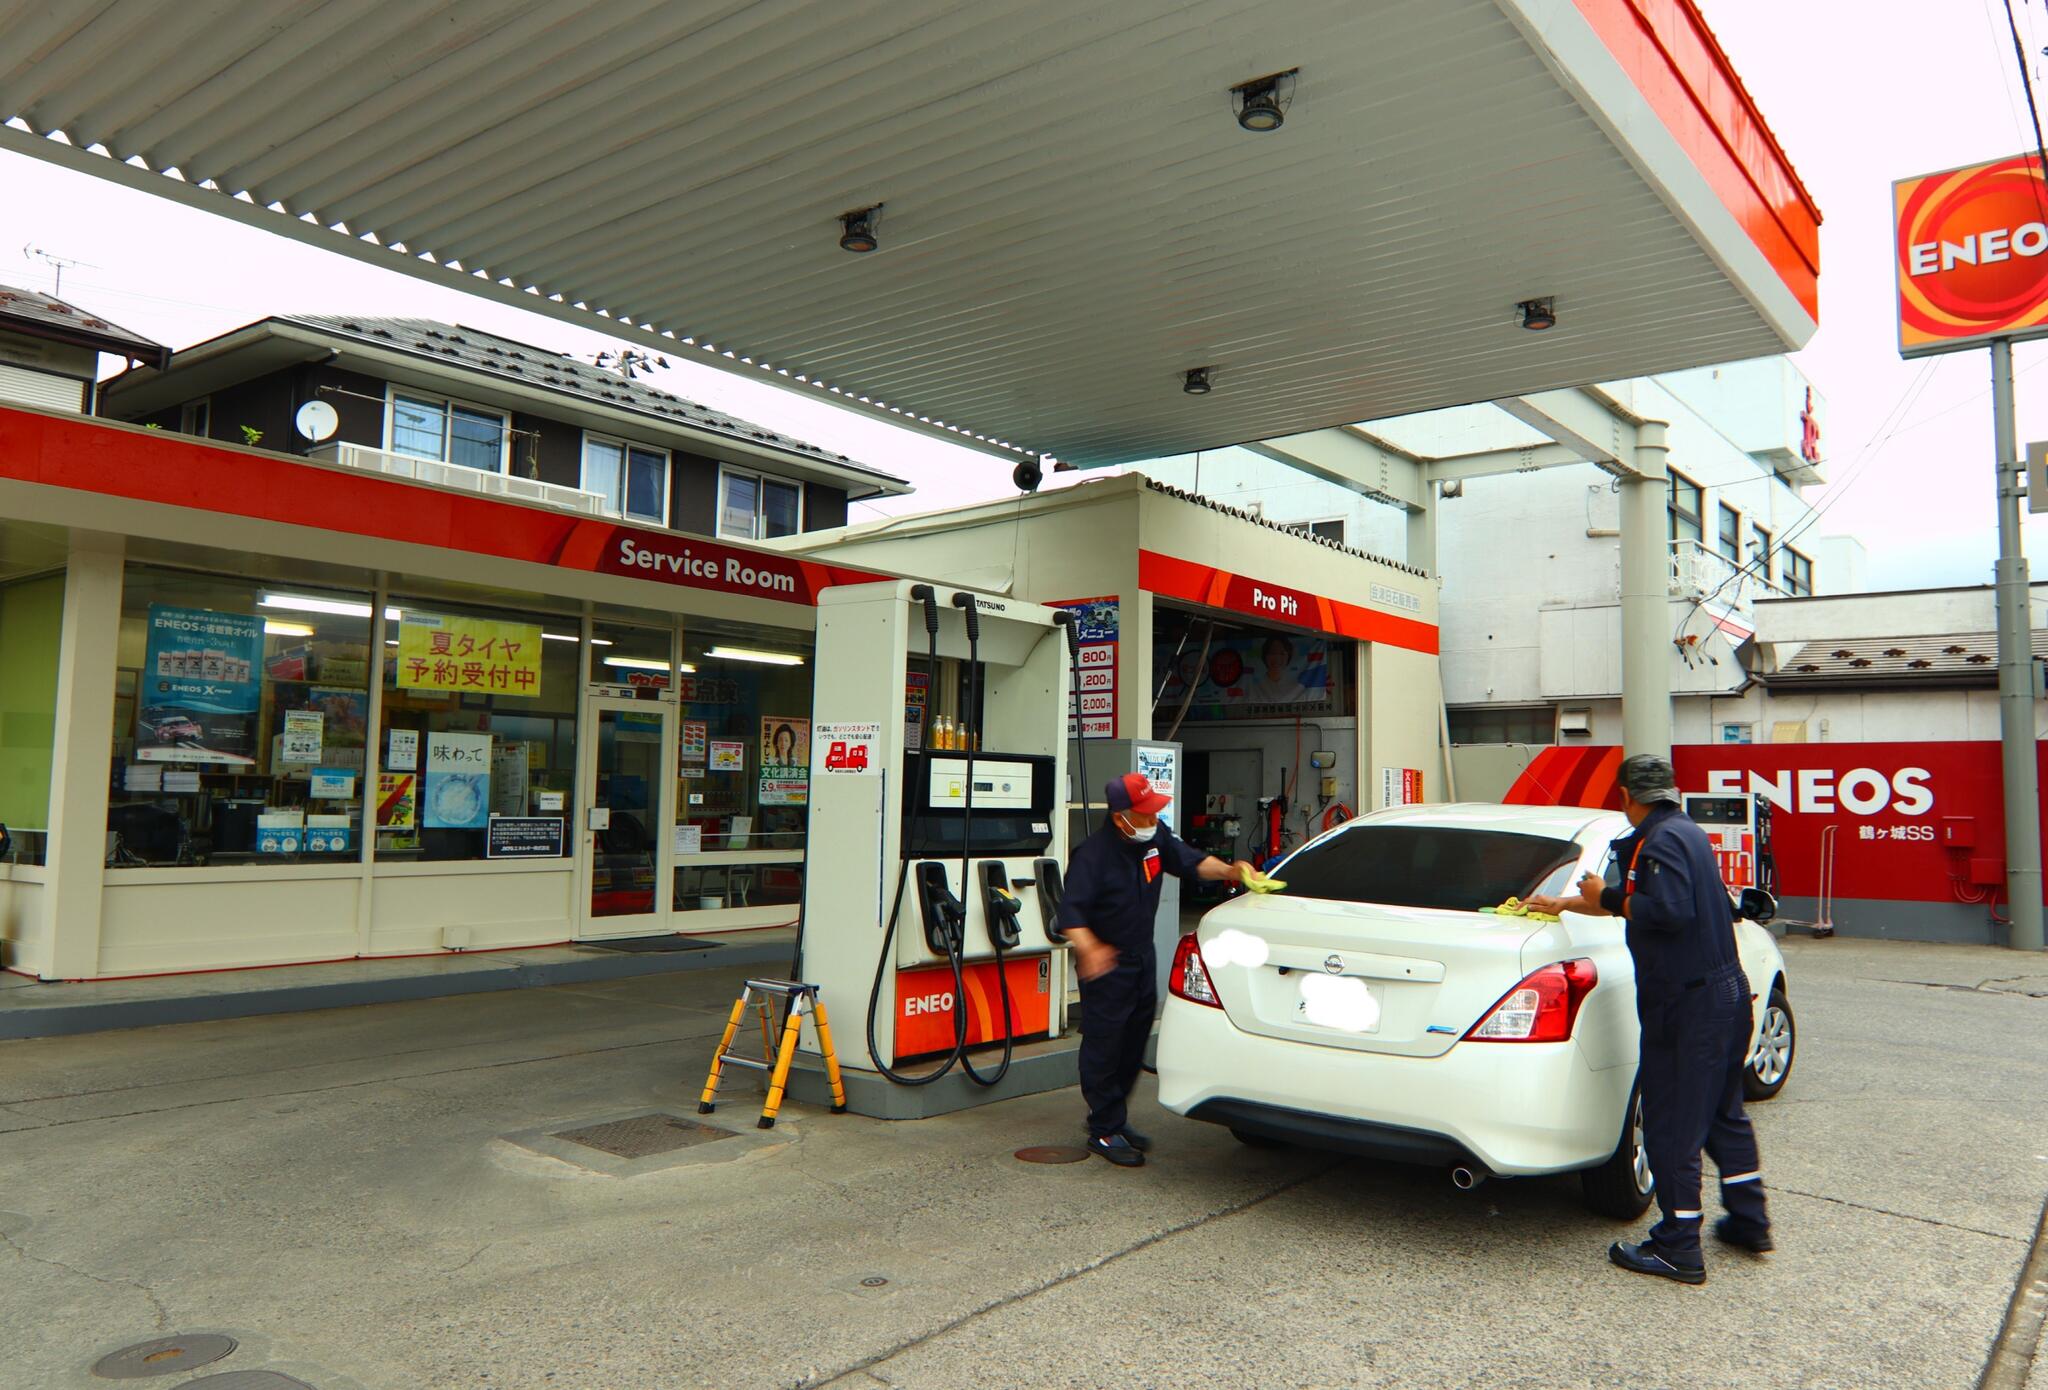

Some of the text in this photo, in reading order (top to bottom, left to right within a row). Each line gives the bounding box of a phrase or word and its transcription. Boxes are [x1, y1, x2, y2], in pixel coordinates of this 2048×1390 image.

[1910, 222, 2048, 277] ENEO
[620, 539, 795, 592] Service Room
[976, 600, 1006, 611] TATSUNO
[1253, 588, 1298, 616] Pro Pit
[429, 631, 521, 661] 夏タイヤ
[406, 658, 535, 690] 予約受付中
[434, 744, 484, 762] 味わって
[761, 767, 808, 779] 文化講演会
[905, 992, 954, 1017] ENEO
